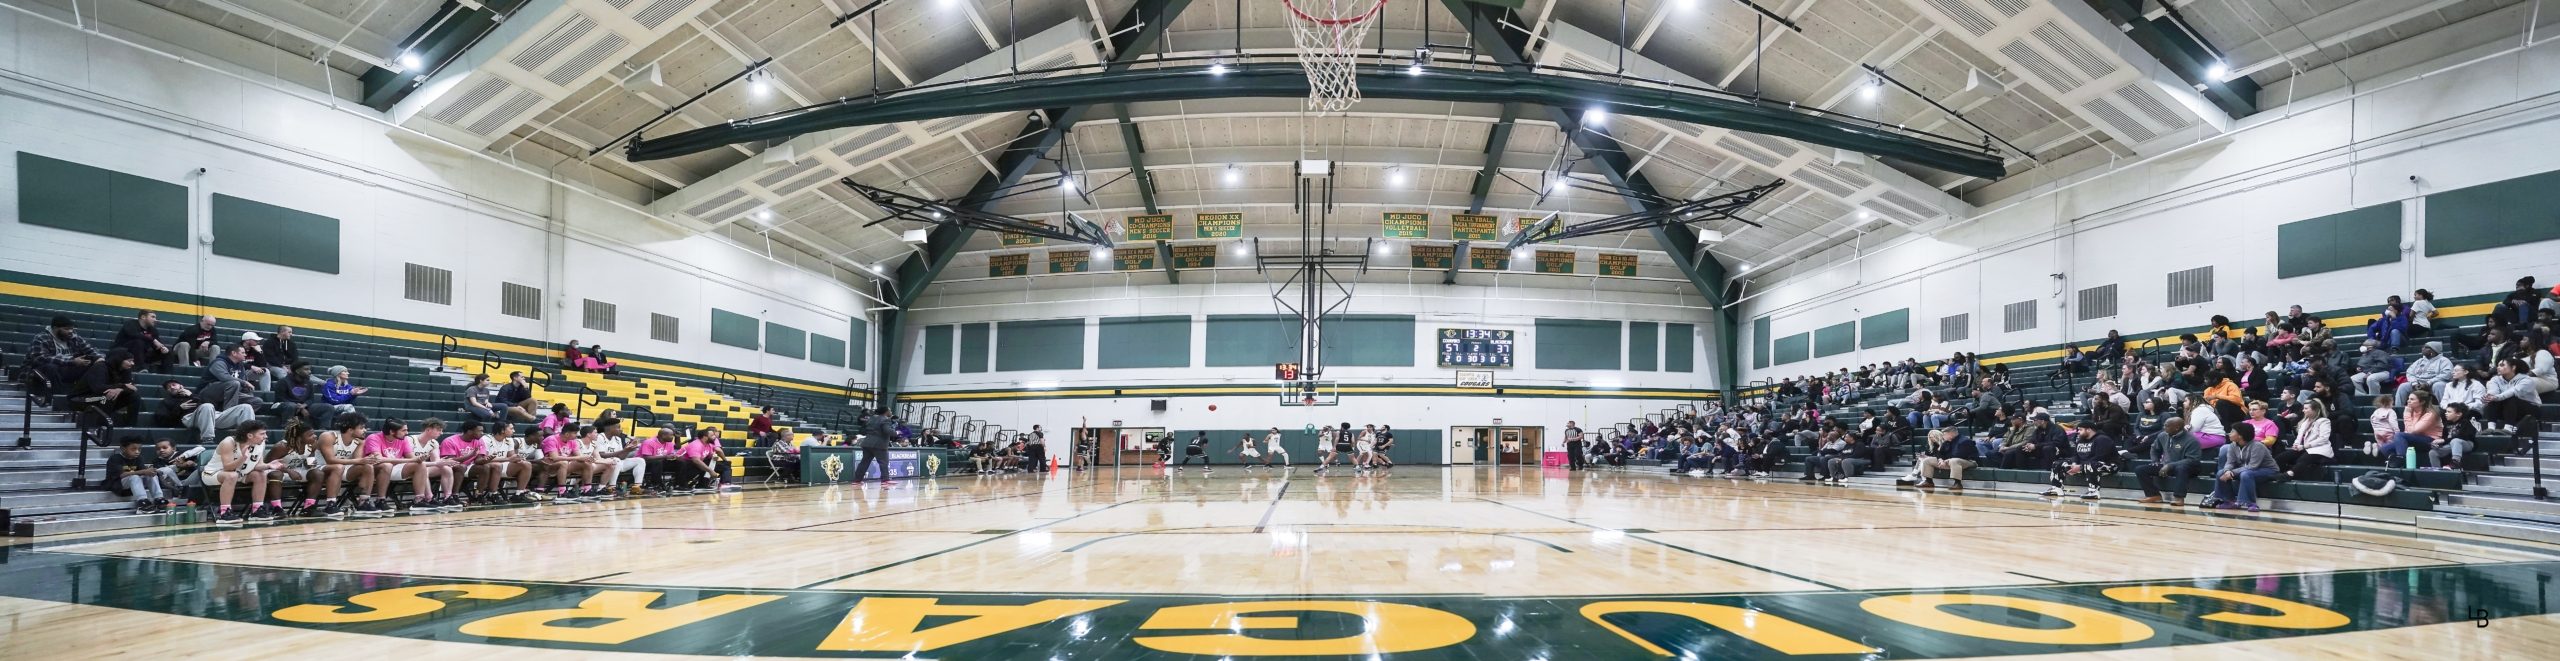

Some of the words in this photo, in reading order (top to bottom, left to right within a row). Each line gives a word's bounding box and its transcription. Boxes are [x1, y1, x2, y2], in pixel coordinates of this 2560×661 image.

[1467, 330, 1490, 338] 13:34
[1446, 344, 1459, 352] 57
[1497, 345, 1509, 353] 37
[1285, 370, 1293, 379] 13
[270, 585, 2352, 658] COUGARS
